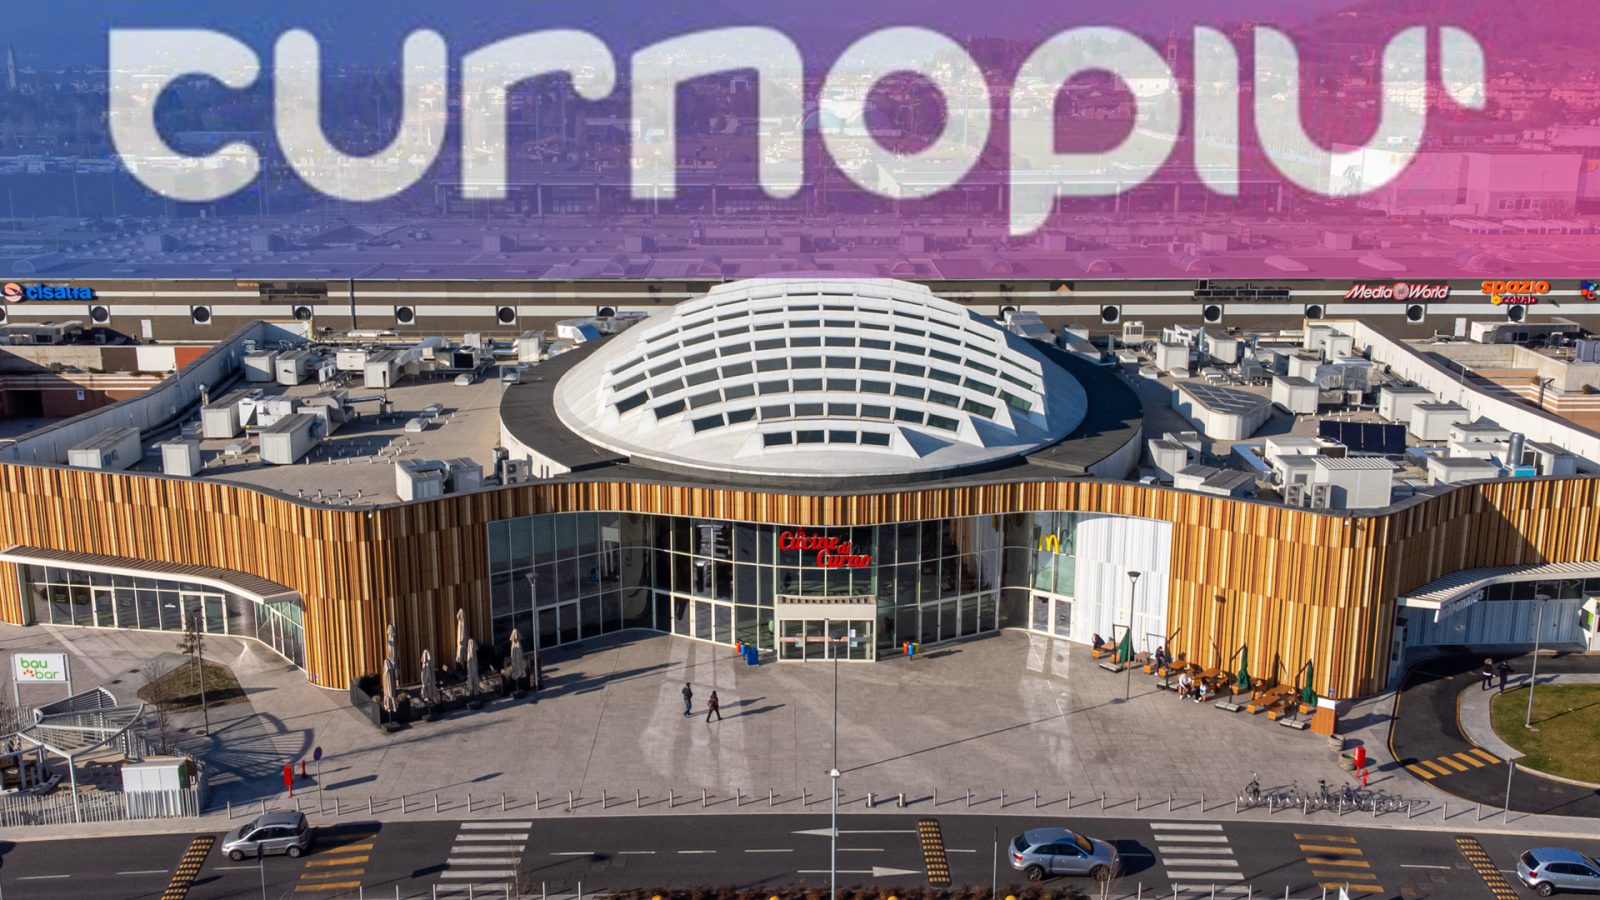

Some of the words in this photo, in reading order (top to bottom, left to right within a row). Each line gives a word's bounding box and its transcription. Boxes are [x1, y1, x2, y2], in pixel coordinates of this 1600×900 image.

[1345, 284, 1393, 299] Media
[1408, 284, 1449, 299] World
[1481, 280, 1550, 298] spazio
[779, 531, 839, 550] Cucine
[816, 549, 872, 568] Curno
[20, 657, 48, 669] bau
[35, 669, 59, 680] bar
